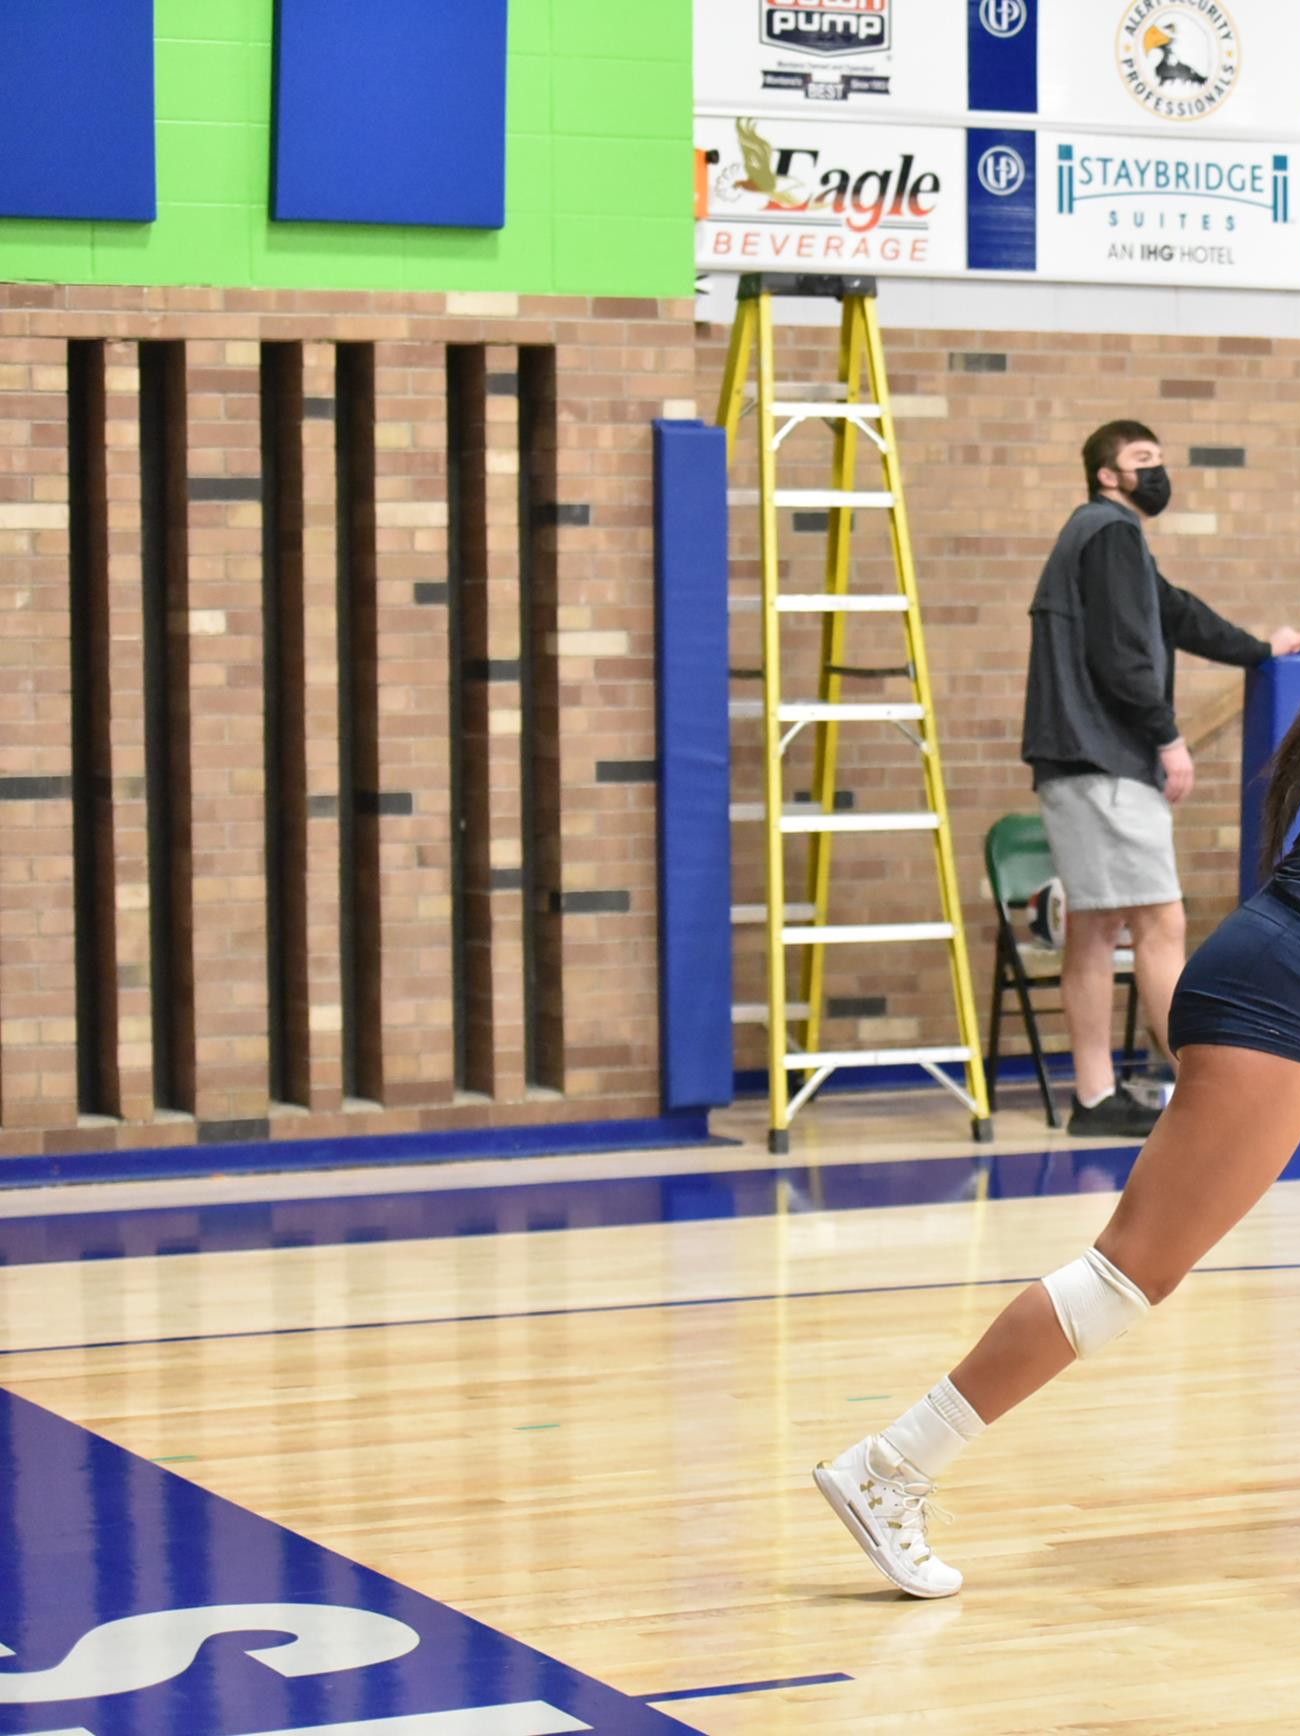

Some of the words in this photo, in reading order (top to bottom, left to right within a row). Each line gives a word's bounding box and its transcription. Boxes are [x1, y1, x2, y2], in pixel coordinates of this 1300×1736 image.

[772, 9, 882, 40] pump
[1122, 58, 1235, 117] PROFESSIONALS
[760, 148, 941, 233] Eagle
[1078, 155, 1265, 194] STAYBRIDGE
[1108, 209, 1236, 232] SUITES
[712, 230, 929, 262] BEVERAGE
[1106, 243, 1135, 261] AN
[1140, 244, 1174, 262] IHG
[1179, 246, 1236, 265] HOTEL
